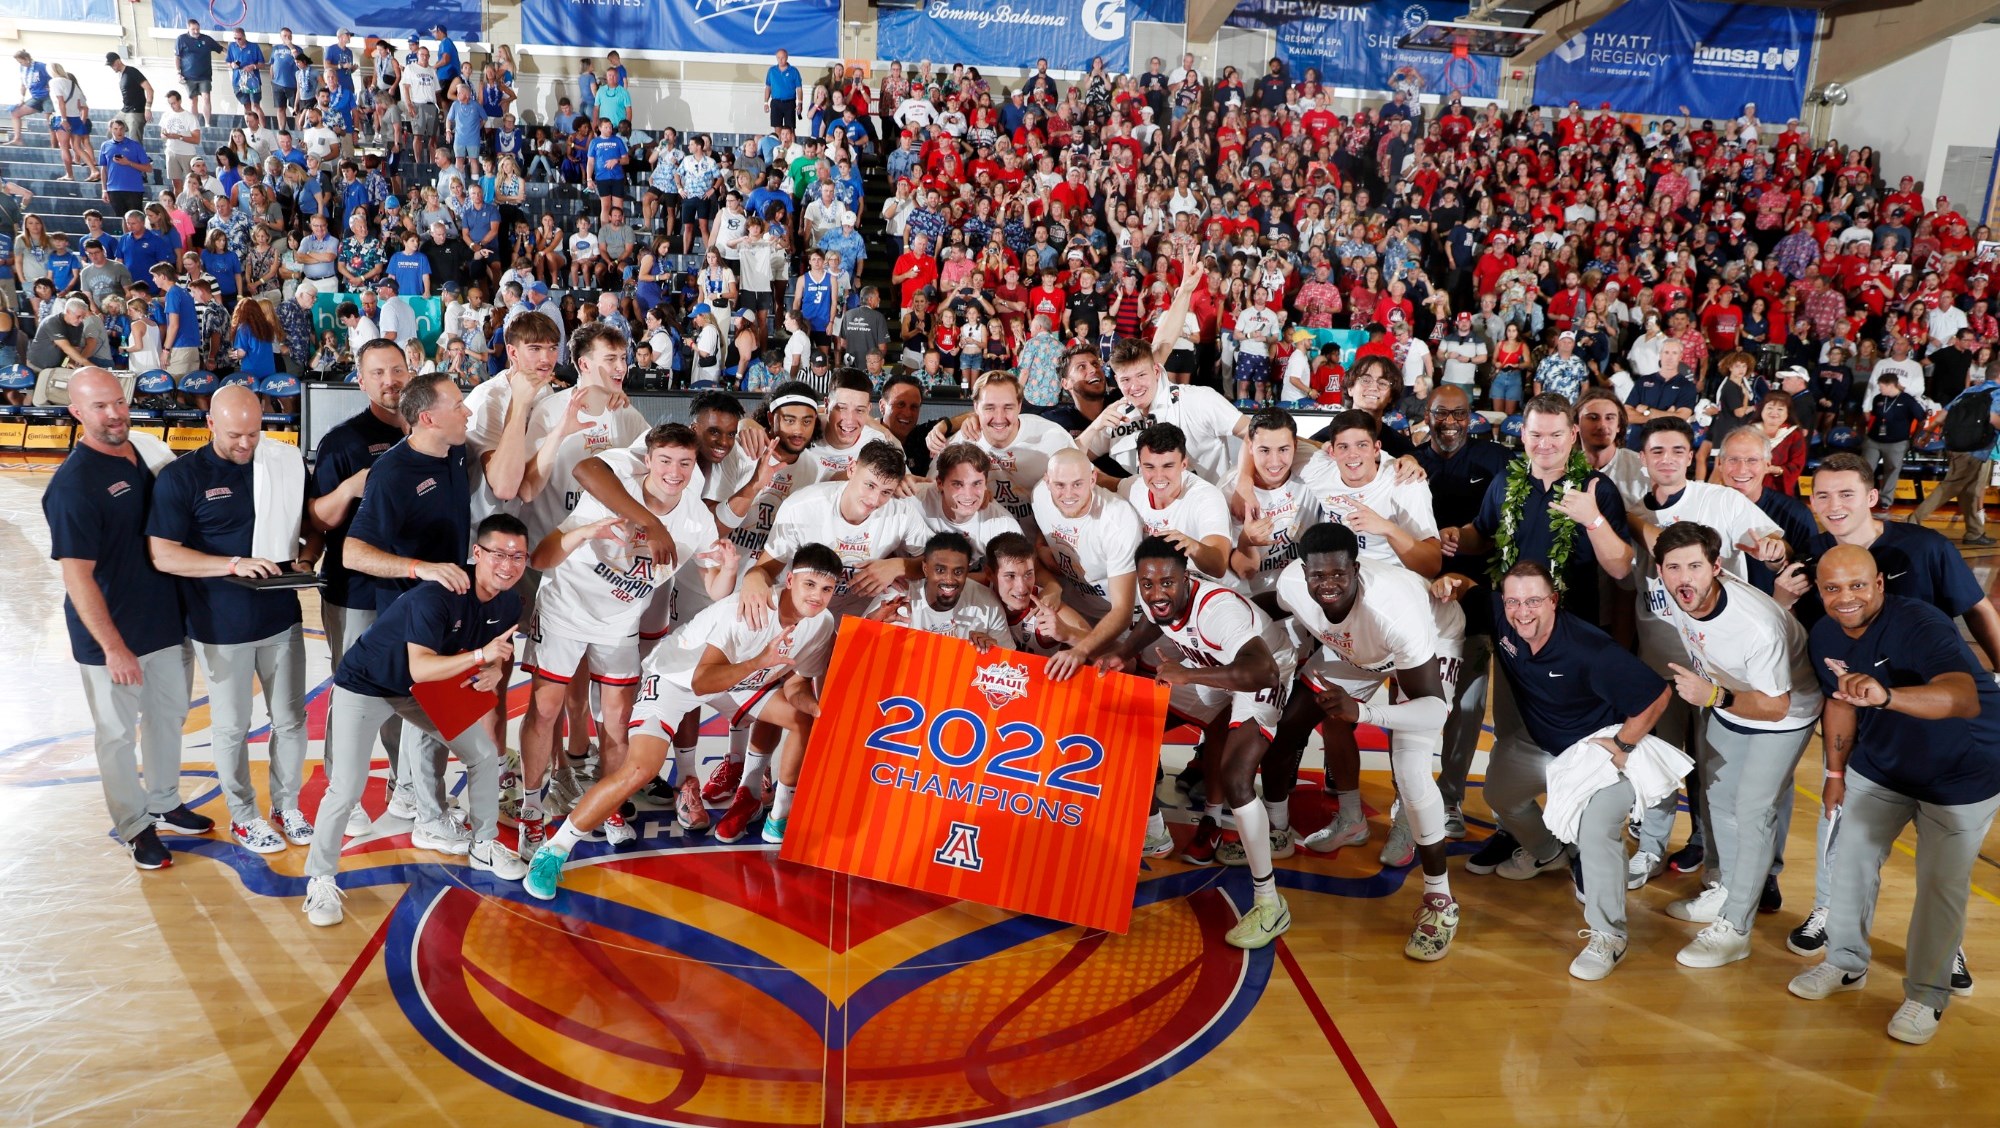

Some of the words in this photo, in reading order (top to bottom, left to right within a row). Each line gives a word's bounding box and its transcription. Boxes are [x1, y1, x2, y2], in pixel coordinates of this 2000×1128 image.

[928, 2, 988, 28] Tommy
[991, 6, 1066, 26] Bahama
[1081, 0, 1126, 41] G
[1299, 3, 1367, 22] WESTIN
[1303, 24, 1326, 33] MAUI
[1284, 35, 1316, 44] RESORT
[1318, 37, 1325, 45] &
[1326, 39, 1342, 47] SPA
[1593, 33, 1651, 48] HYATT
[1381, 53, 1398, 61] Maui
[1399, 54, 1421, 63] Resort
[1431, 57, 1444, 66] Spa
[1590, 49, 1668, 66] REGENCY
[1694, 41, 1760, 63] hmsa
[1590, 66, 1606, 74] MAUI
[1606, 68, 1632, 76] RESORT
[1327, 375, 1341, 392] A
[27, 433, 63, 441] Continental
[168, 434, 203, 442] Continental
[587, 436, 609, 445] MAUI
[769, 482, 790, 493] AUI
[994, 480, 1019, 503] A
[1265, 503, 1293, 518] MAUI
[1054, 530, 1077, 545] MAUI
[749, 550, 761, 560] 20
[839, 543, 867, 552] MAUI
[624, 556, 655, 582] A
[593, 562, 654, 600] CHAMPIO
[611, 587, 635, 604] 2022
[980, 673, 1023, 691] MAUI
[864, 695, 1105, 799] 2022
[869, 762, 1084, 828] CHAMPIONS
[933, 820, 984, 873] A
